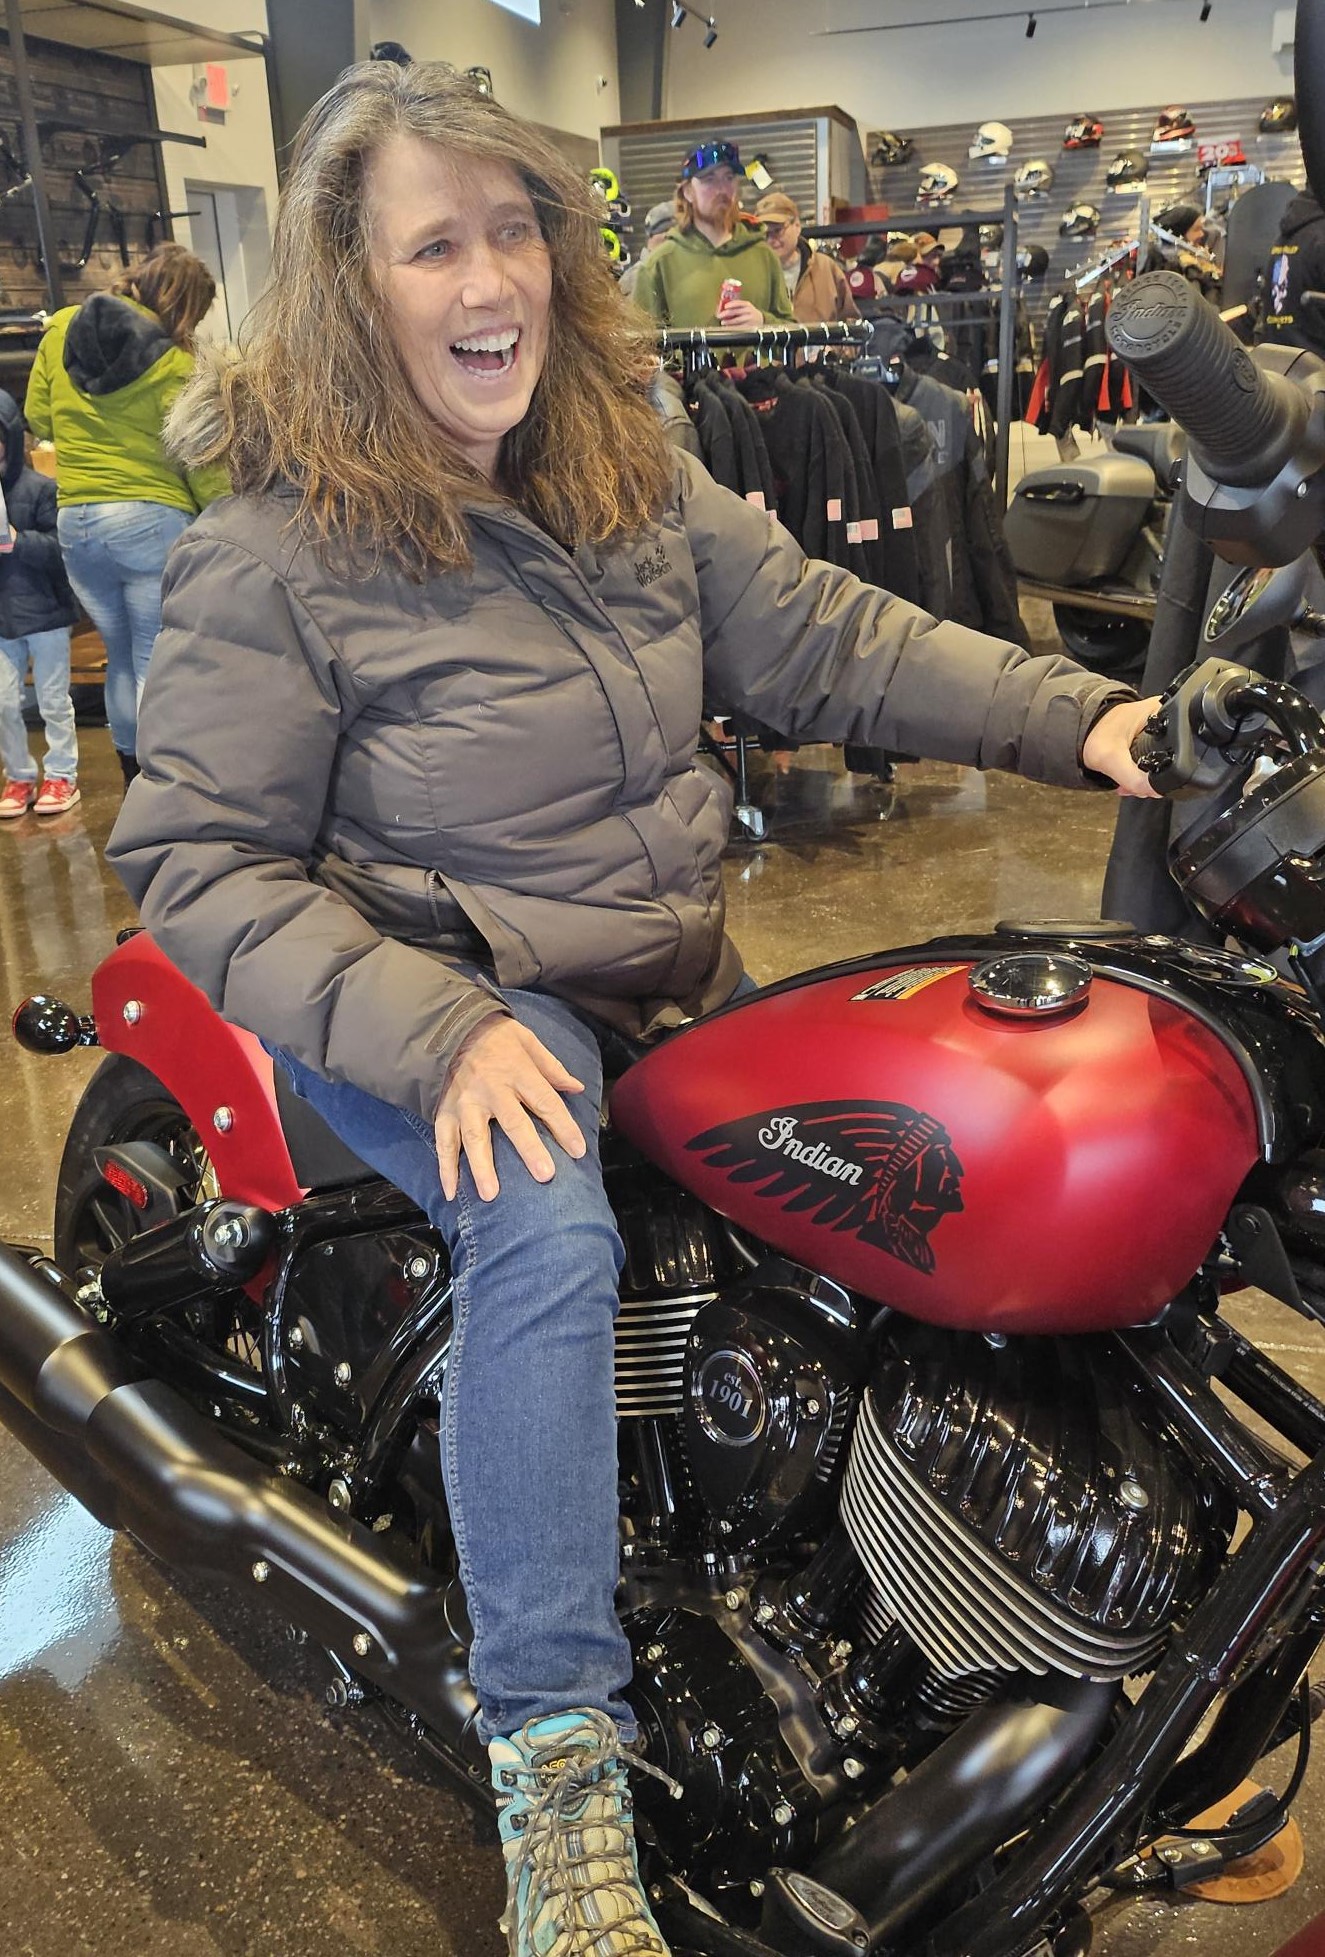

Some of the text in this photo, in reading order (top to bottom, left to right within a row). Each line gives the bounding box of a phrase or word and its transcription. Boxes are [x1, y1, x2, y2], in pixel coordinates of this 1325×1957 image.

[634, 555, 654, 576] Jack
[637, 562, 672, 588] Wolfskin
[758, 1116, 863, 1186] Indian
[709, 1379, 754, 1419] 1901
